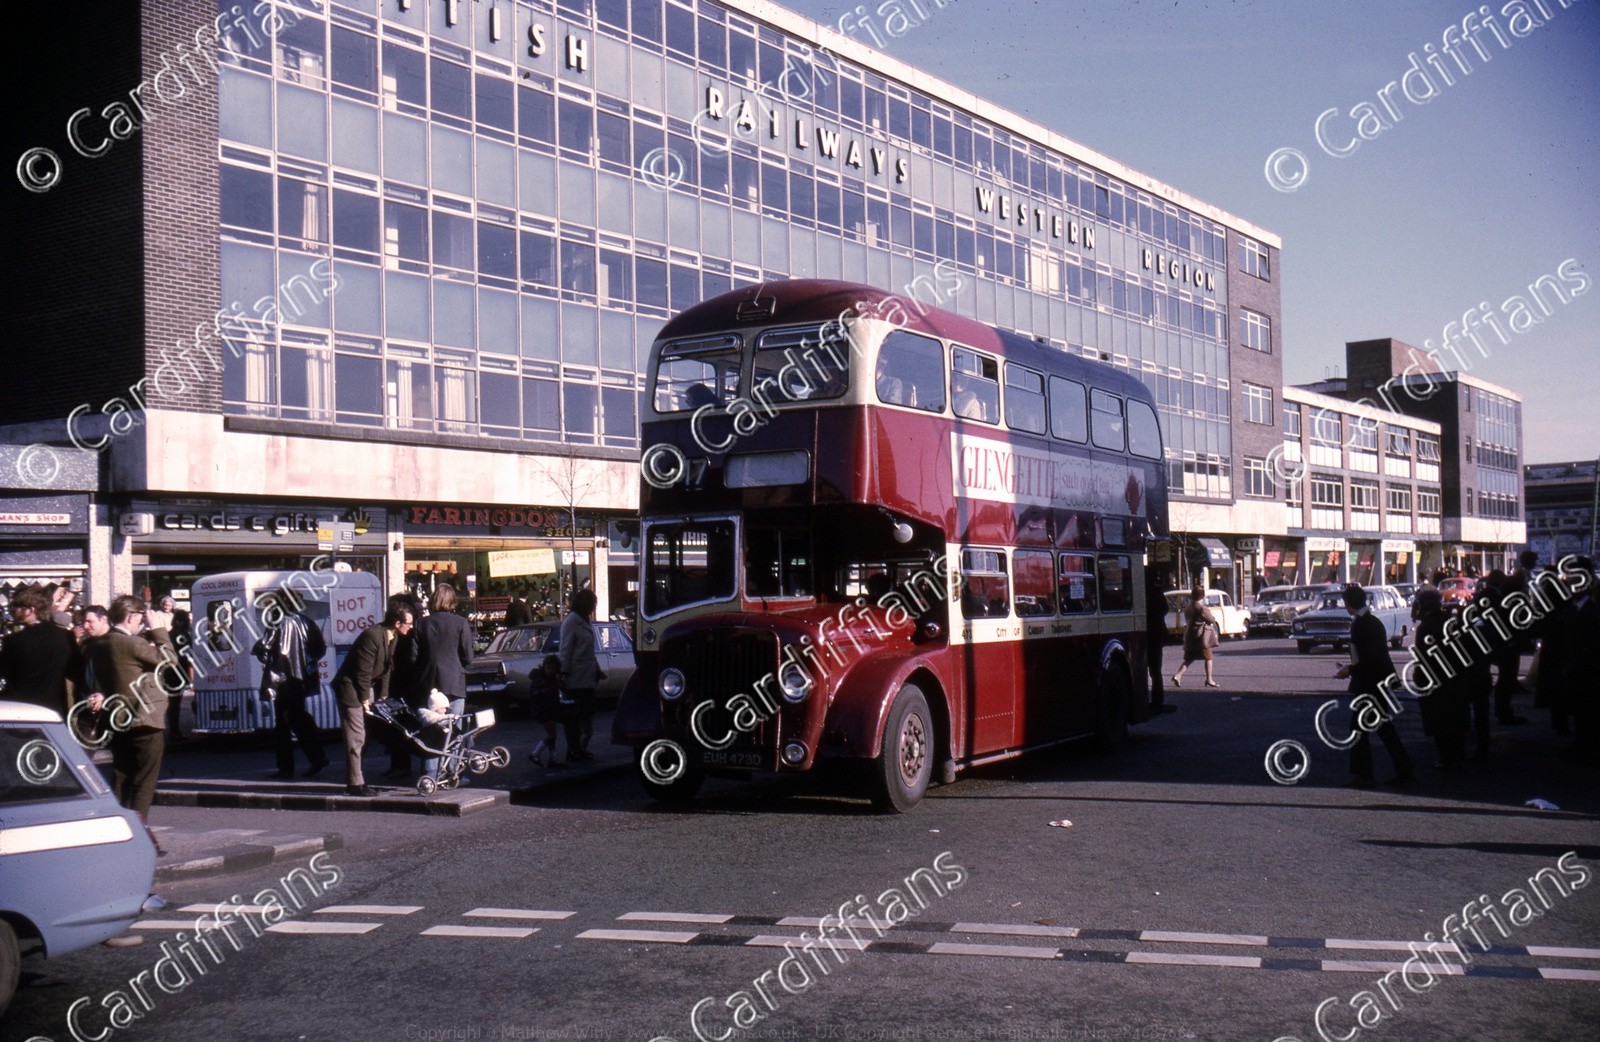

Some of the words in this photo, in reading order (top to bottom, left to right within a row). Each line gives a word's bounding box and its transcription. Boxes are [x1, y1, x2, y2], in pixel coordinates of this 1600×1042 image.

[400, 0, 588, 71] TISH
[707, 86, 908, 183] RAILWAYS
[976, 186, 1095, 250] WESTERN
[1141, 249, 1217, 291] REGION
[960, 445, 1059, 500] GLENGETTIE
[163, 511, 241, 530] cards
[275, 512, 323, 535] gifts
[412, 506, 560, 528] FARINGDON
[545, 527, 592, 538] SHOES
[201, 581, 217, 590] COOL
[218, 579, 239, 588] DRINKS
[336, 596, 366, 612] HOT
[336, 614, 376, 634] DOGS
[996, 627, 1007, 638] CITY
